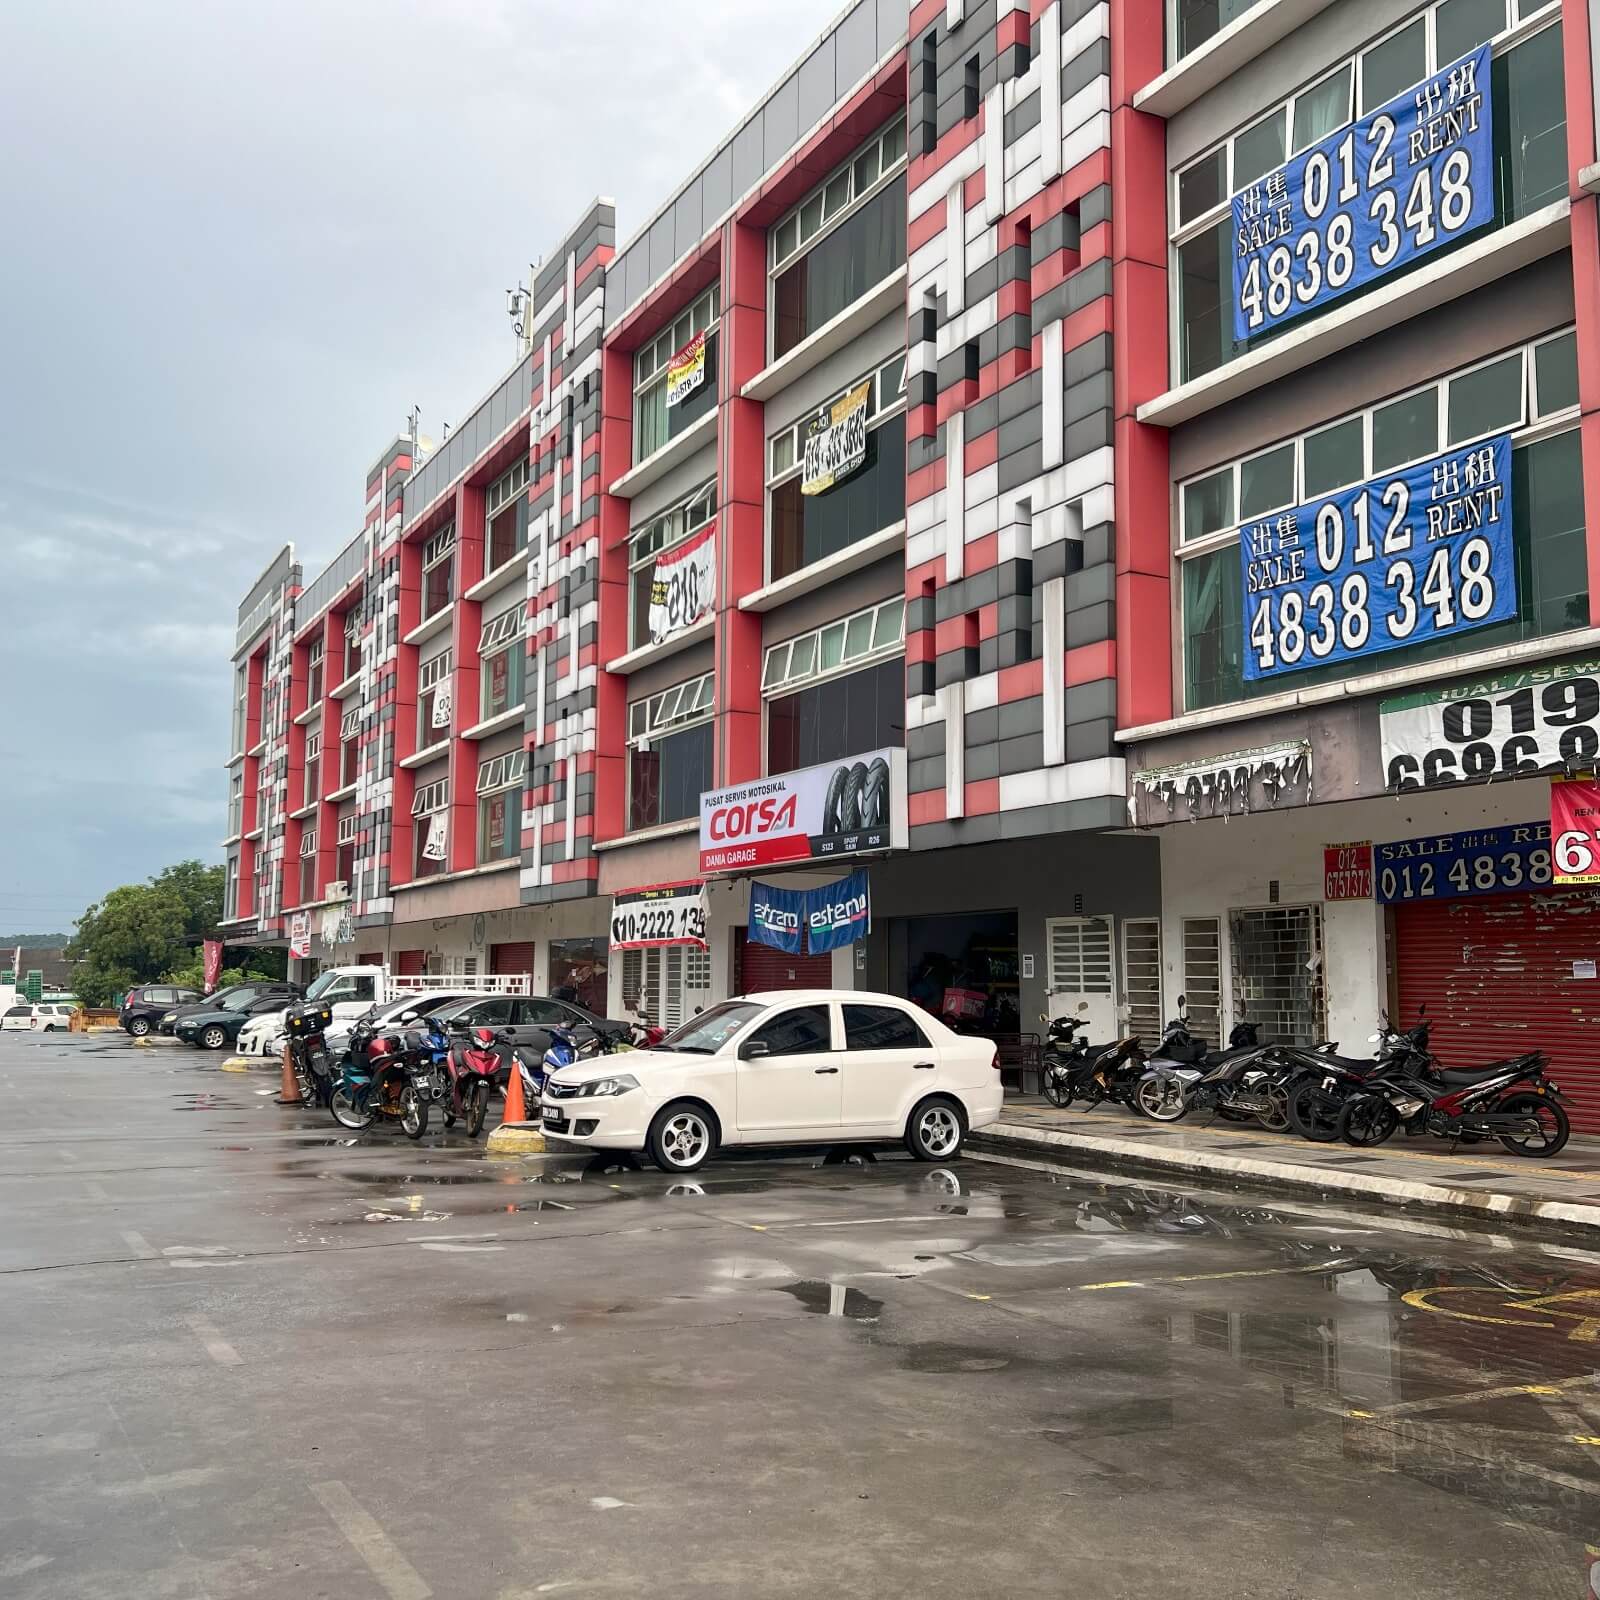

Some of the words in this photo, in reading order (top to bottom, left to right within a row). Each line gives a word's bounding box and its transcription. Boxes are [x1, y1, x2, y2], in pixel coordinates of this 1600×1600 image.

[1415, 60, 1477, 125] 出租
[1408, 95, 1481, 165] RENT
[1303, 115, 1395, 218] 012
[1242, 172, 1288, 221] 出售
[1238, 203, 1293, 257] SALE
[1241, 214, 1353, 328] 4838
[1370, 150, 1472, 267] 348
[1431, 446, 1496, 501] 出租
[1252, 514, 1299, 557] 出售
[1315, 481, 1411, 572] 012
[1426, 485, 1502, 542] RENT
[1248, 550, 1305, 593] SALE
[1251, 574, 1369, 669] 4838
[1386, 538, 1494, 638] 348
[1443, 678, 1600, 743] 019
[705, 796, 723, 808] PUSAT
[725, 790, 747, 804] SERVIS
[748, 780, 786, 799] MOTOSIKAL
[706, 853, 726, 867] DANIA
[727, 848, 756, 863] GARAGE
[1339, 849, 1357, 869] 012
[1381, 863, 1435, 899] 012
[1449, 849, 1551, 892] 4838
[1382, 838, 1453, 860] SALE
[1554, 829, 1600, 875] 6
[1327, 869, 1371, 898] 6757373
